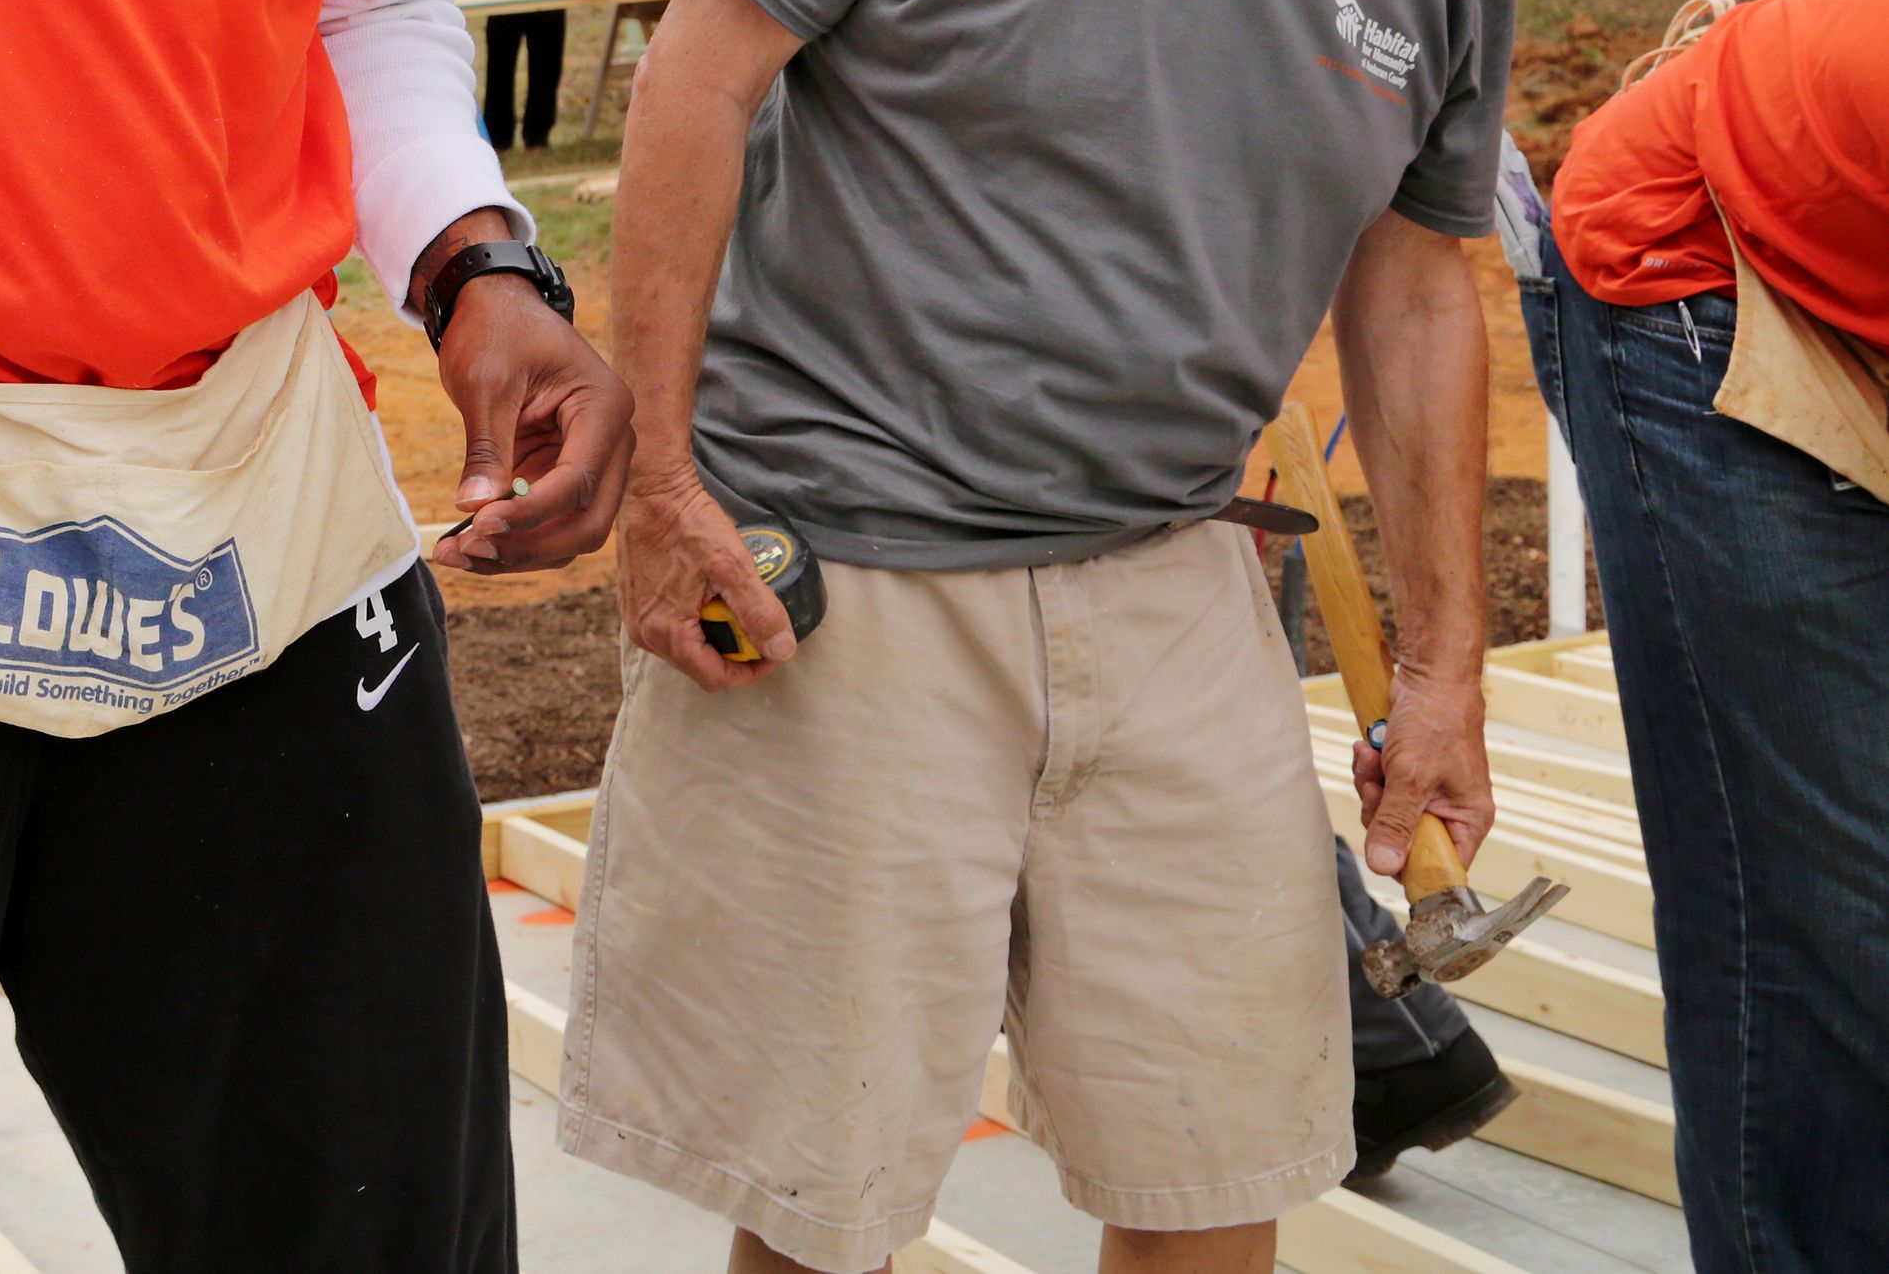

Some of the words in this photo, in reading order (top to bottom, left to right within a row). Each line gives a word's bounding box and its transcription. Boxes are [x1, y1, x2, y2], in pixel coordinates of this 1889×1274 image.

[1364, 18, 1420, 62] Habitat
[356, 590, 397, 653] 4
[36, 677, 154, 713] Something
[162, 665, 248, 708] Together
